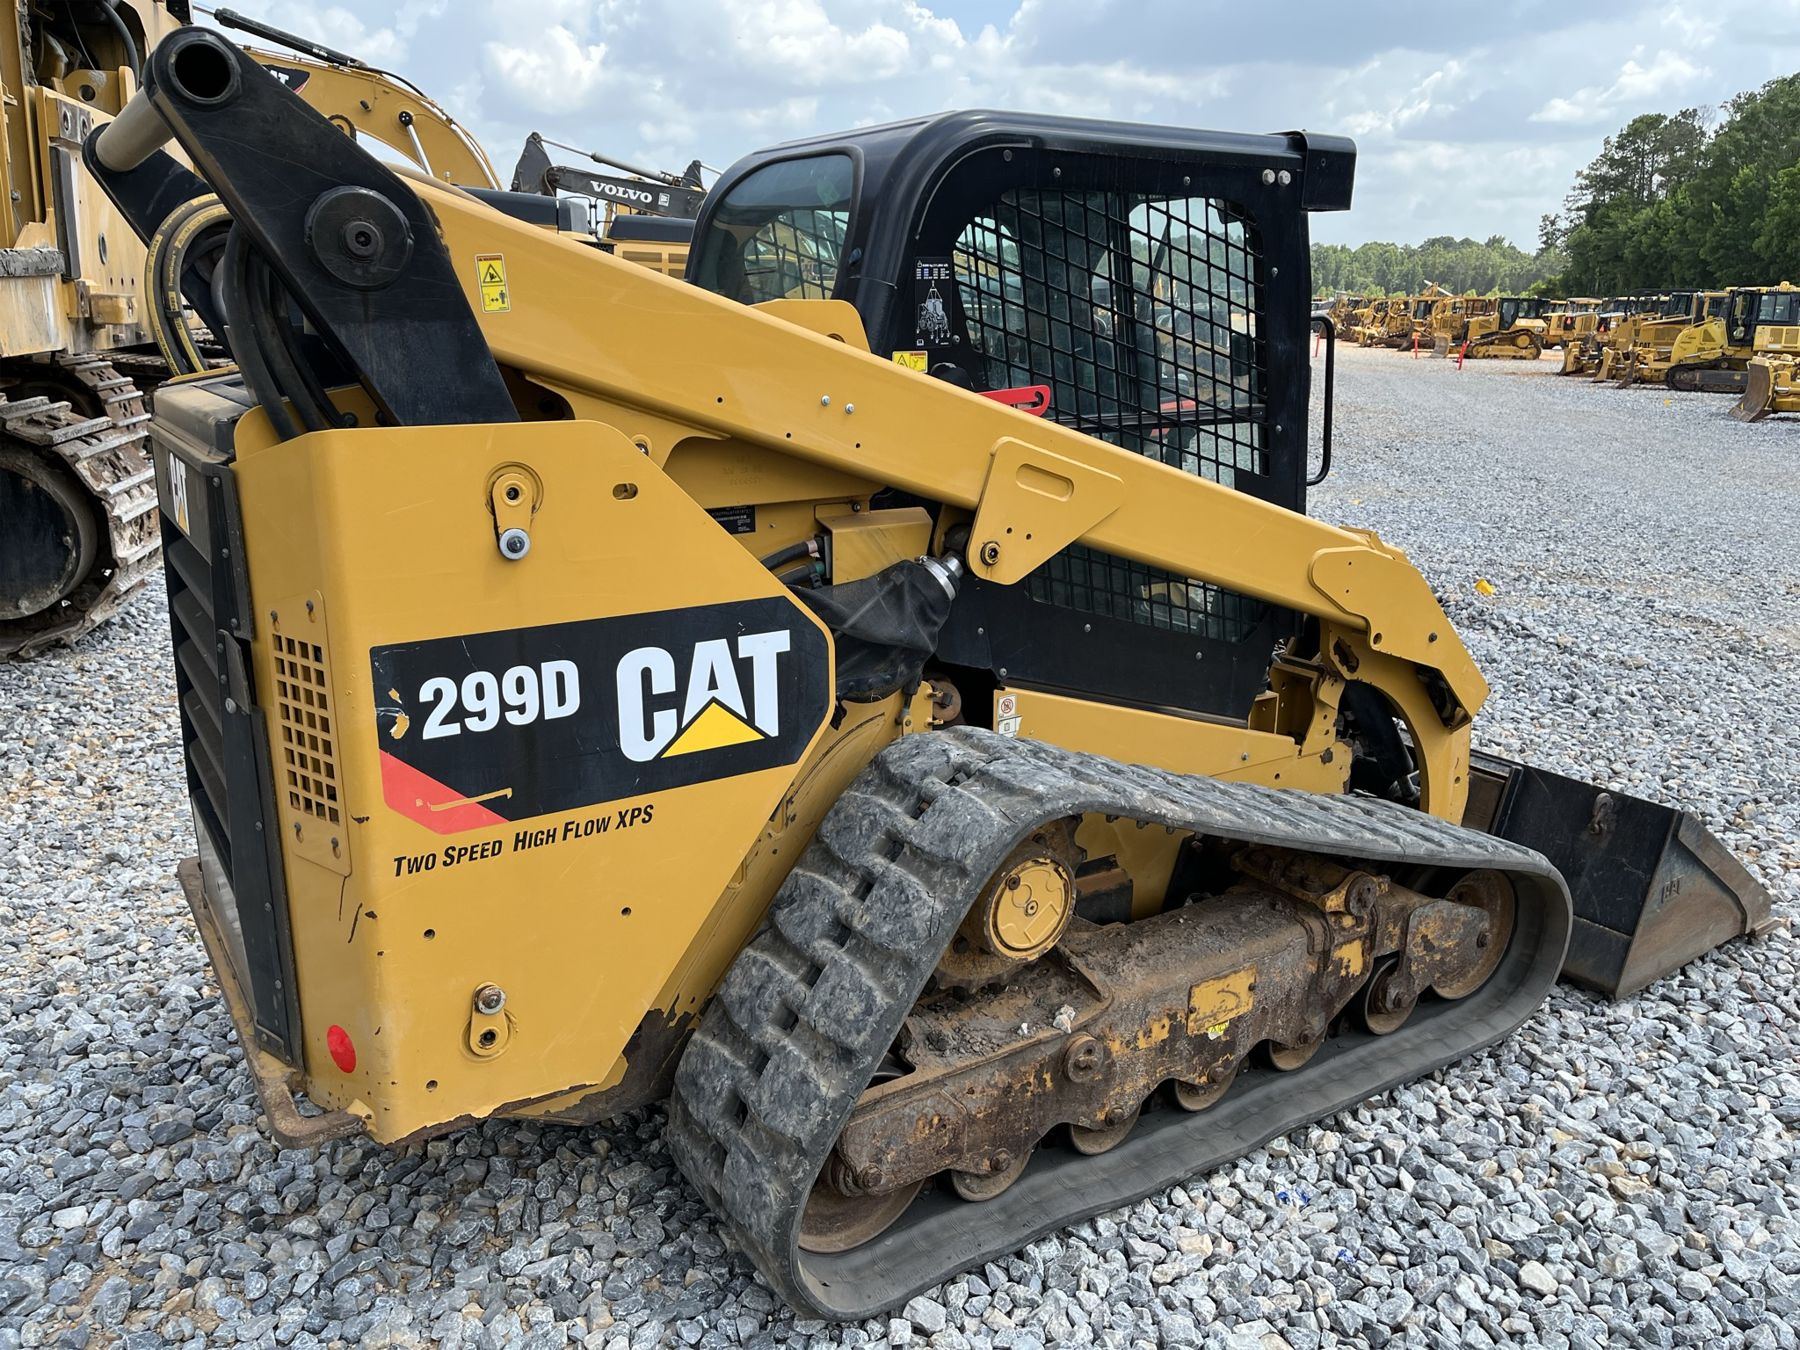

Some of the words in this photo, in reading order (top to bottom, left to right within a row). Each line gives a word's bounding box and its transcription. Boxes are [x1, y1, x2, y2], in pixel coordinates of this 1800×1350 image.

[590, 180, 653, 204] VOLVO
[169, 452, 191, 536] CAT
[418, 659, 581, 740] 299D
[616, 629, 791, 763] CAT
[616, 804, 654, 830] XPS
